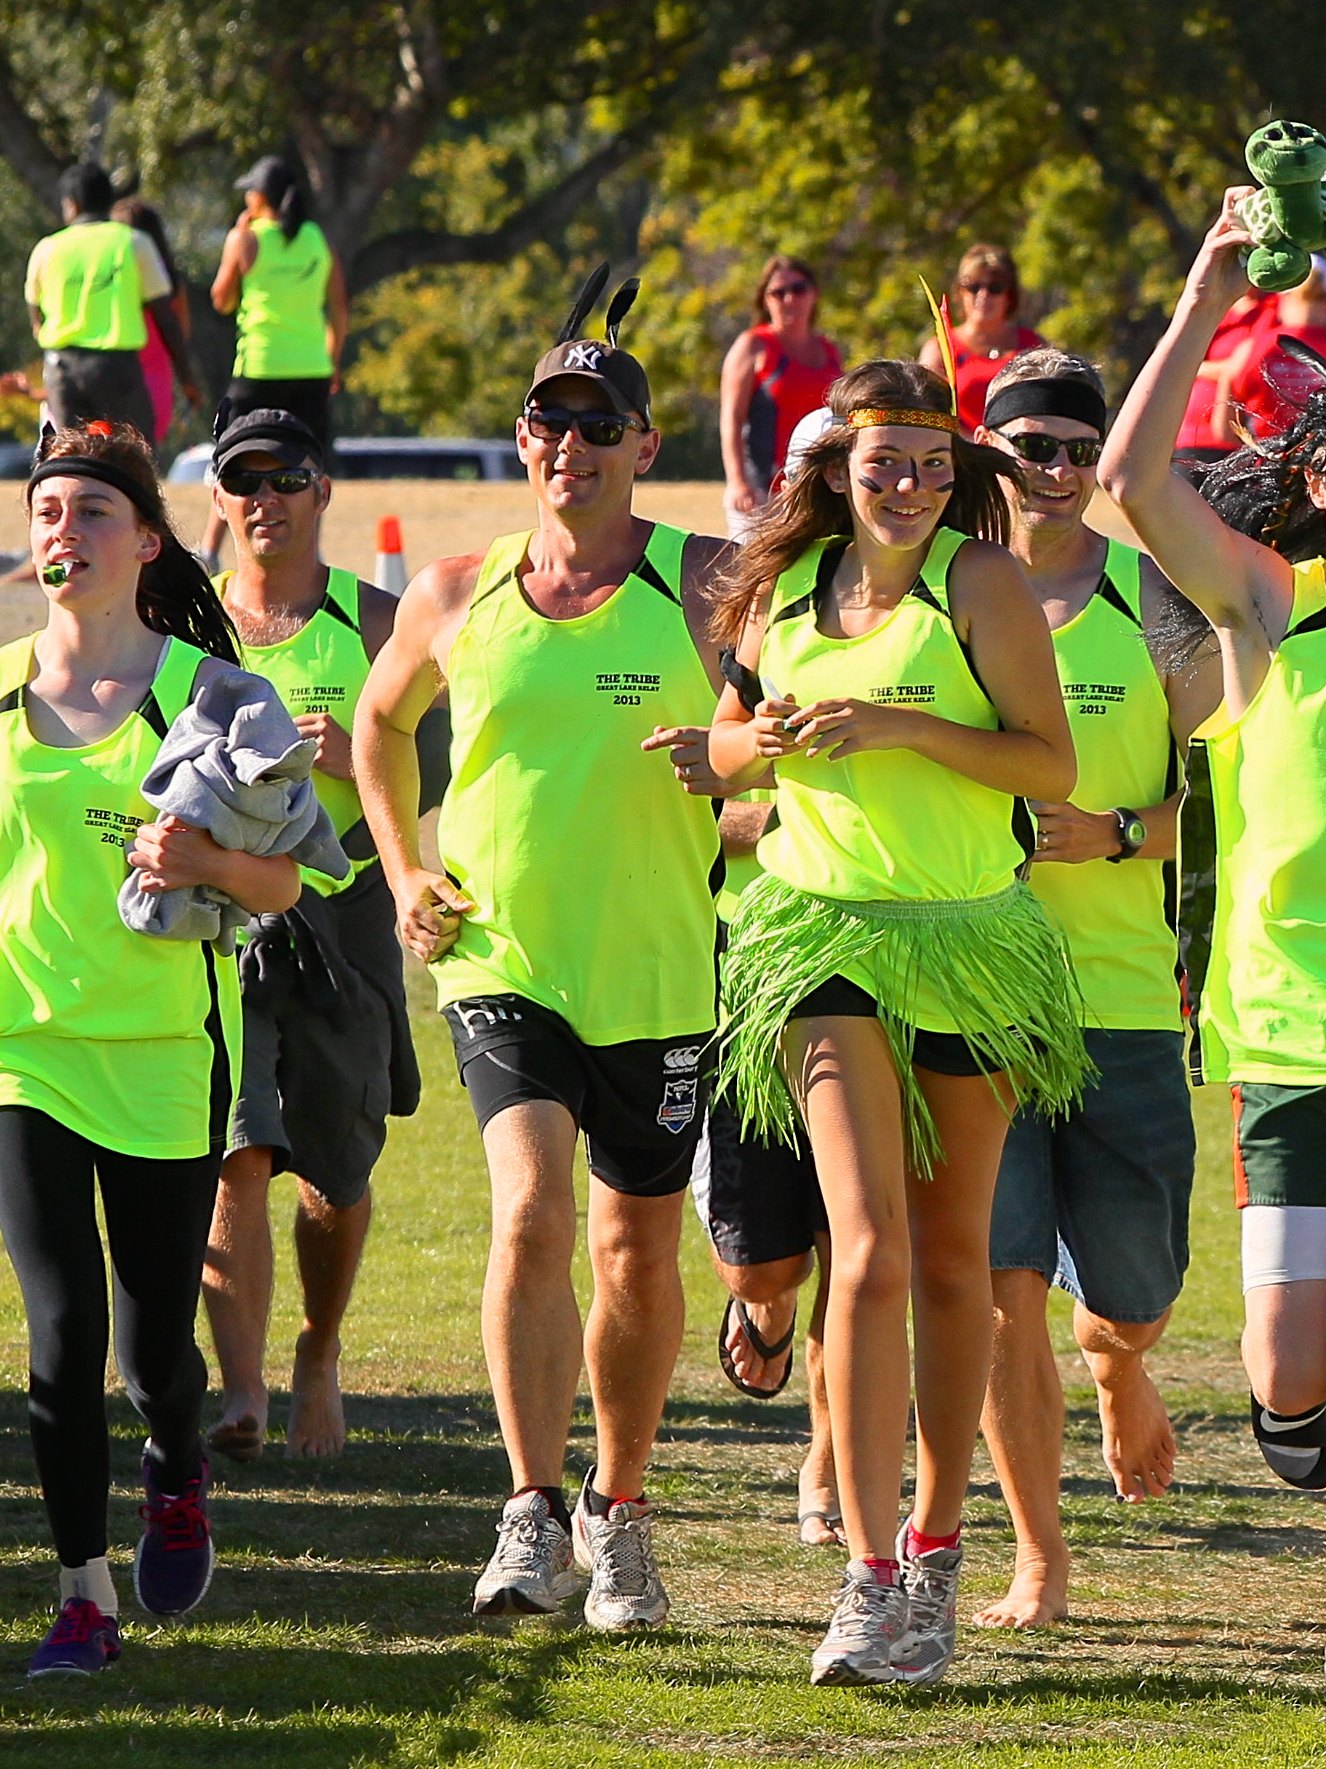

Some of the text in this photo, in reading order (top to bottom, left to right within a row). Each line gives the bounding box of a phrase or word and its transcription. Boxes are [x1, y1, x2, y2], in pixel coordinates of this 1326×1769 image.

[596, 674, 660, 684] THE TRIBE
[290, 687, 345, 696] THE TRIBE
[868, 685, 935, 697] THE TRIBE
[1063, 684, 1126, 695] THE TRIBE
[613, 695, 641, 705] 2013
[305, 704, 329, 713] 2013
[1079, 705, 1106, 714] 2013
[86, 808, 144, 827] THE TRIBE
[101, 832, 125, 847] 2013
